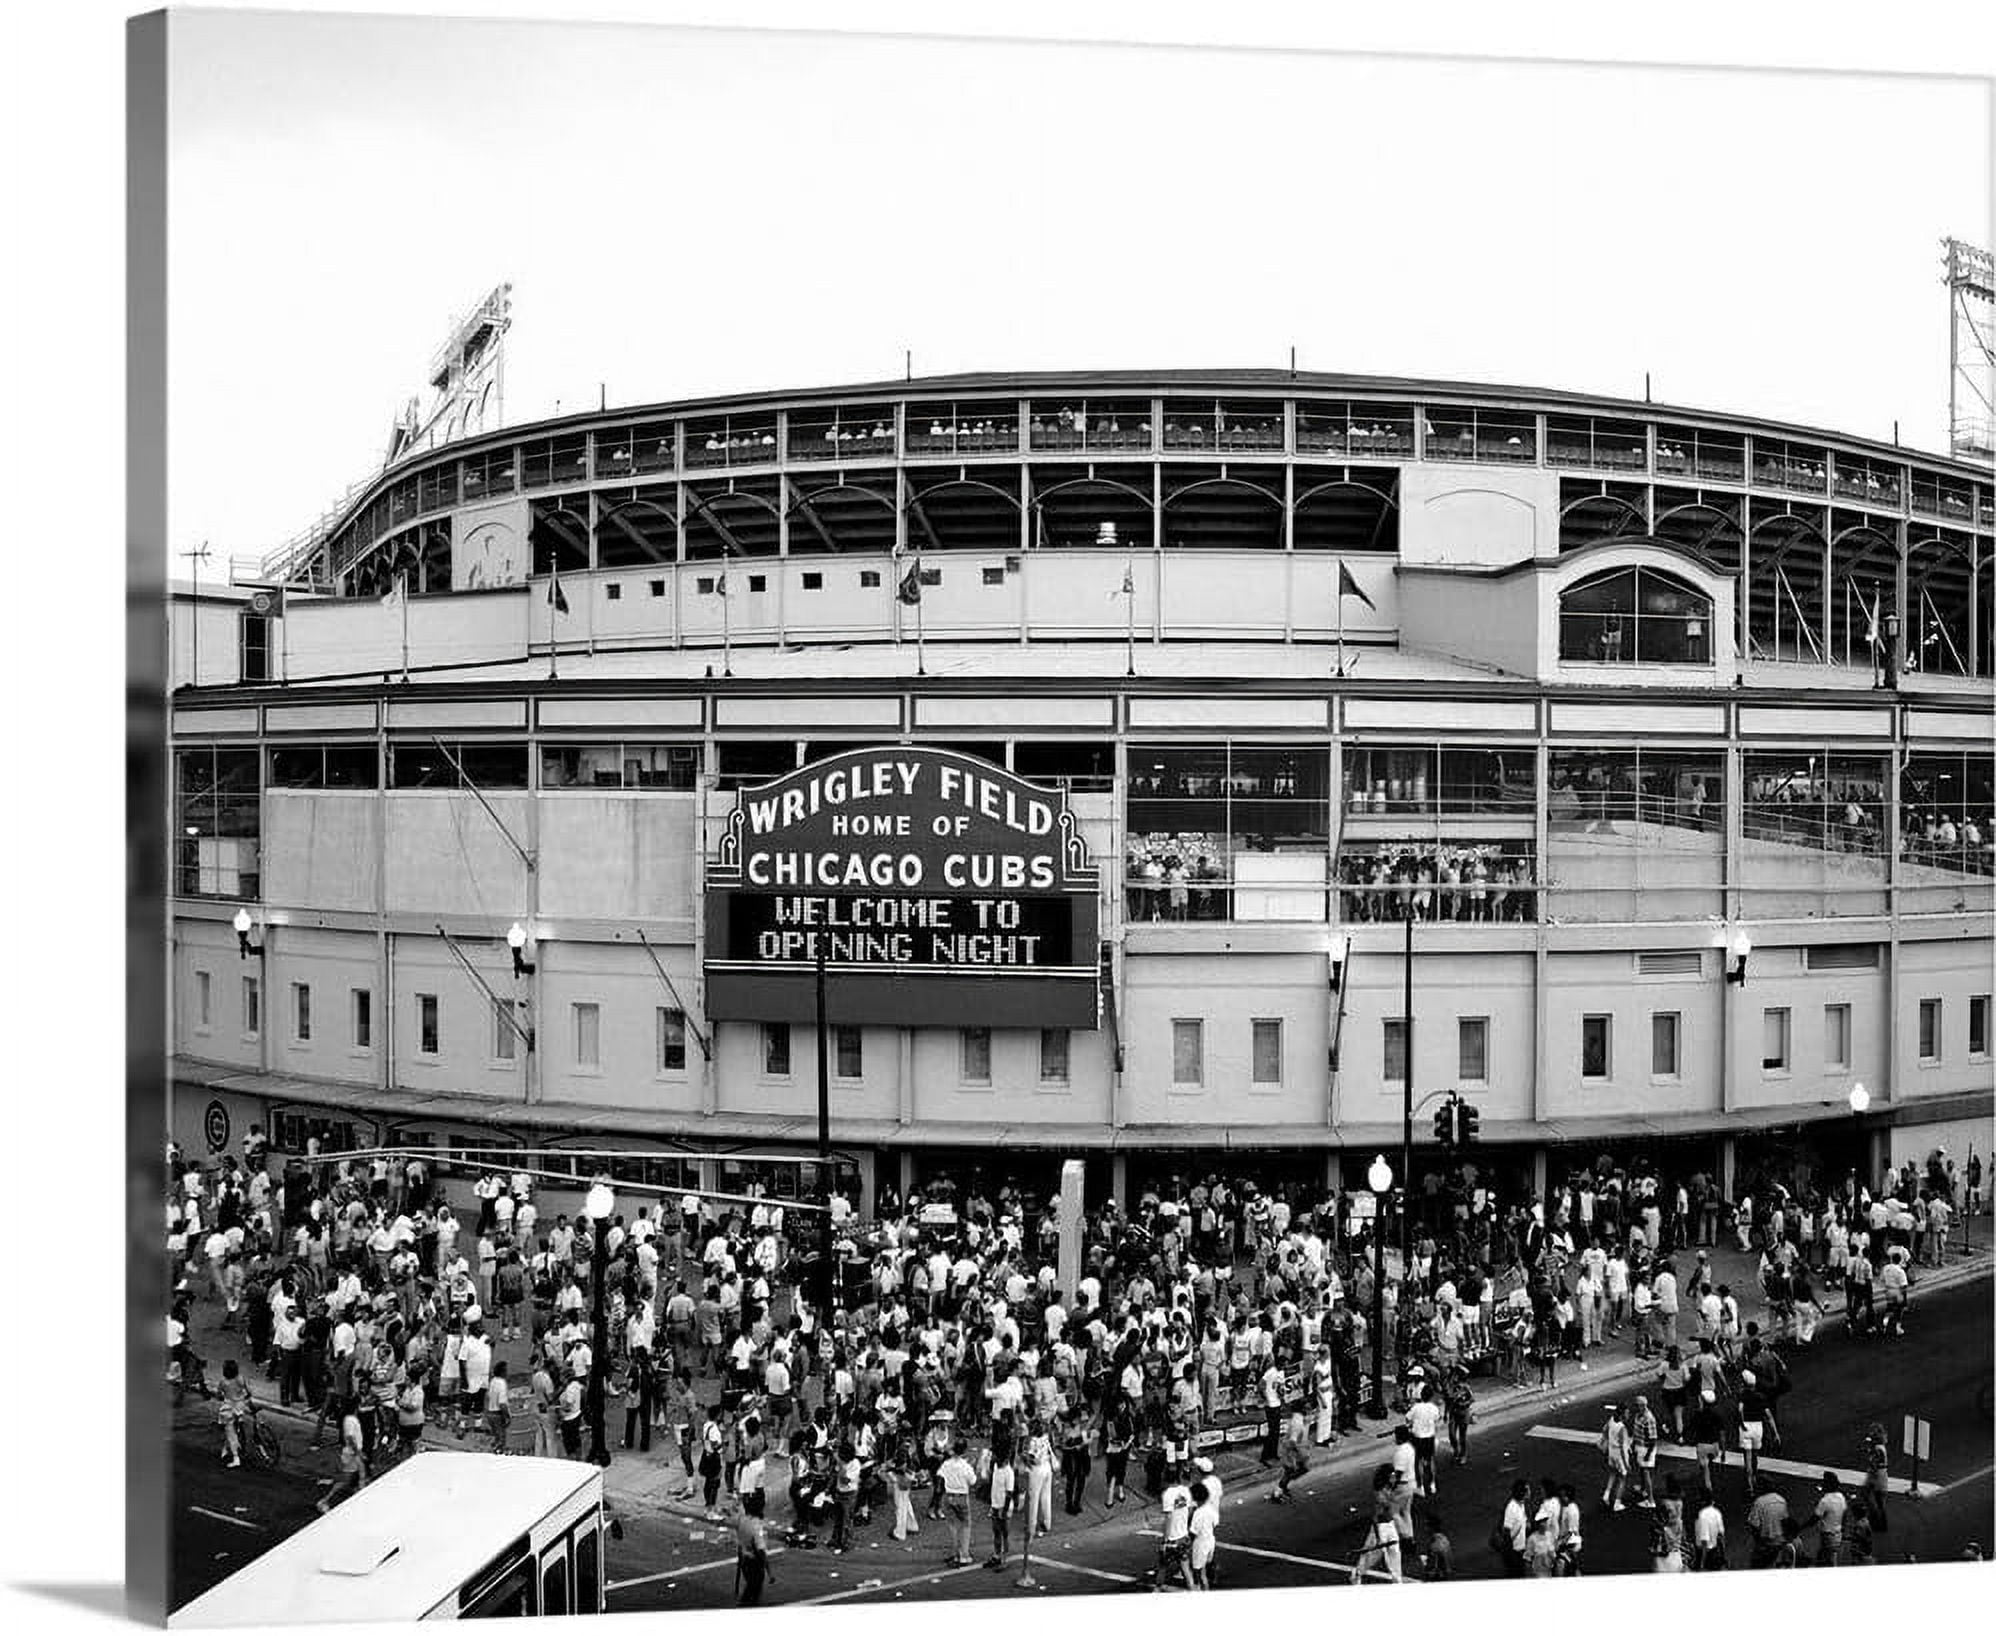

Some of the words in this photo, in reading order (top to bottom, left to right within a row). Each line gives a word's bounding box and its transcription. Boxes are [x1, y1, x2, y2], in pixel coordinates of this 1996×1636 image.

[749, 762, 921, 834] WRIGLEY
[941, 766, 1052, 835] FIELD
[832, 815, 911, 836] HOME
[933, 815, 970, 836] OF
[748, 852, 923, 887] CHICAGO
[943, 854, 1054, 888] CUBS
[776, 897, 952, 927] WELCOME
[972, 899, 1020, 928] TO
[759, 931, 912, 961] OPENING
[932, 934, 1041, 964] NIGHT
